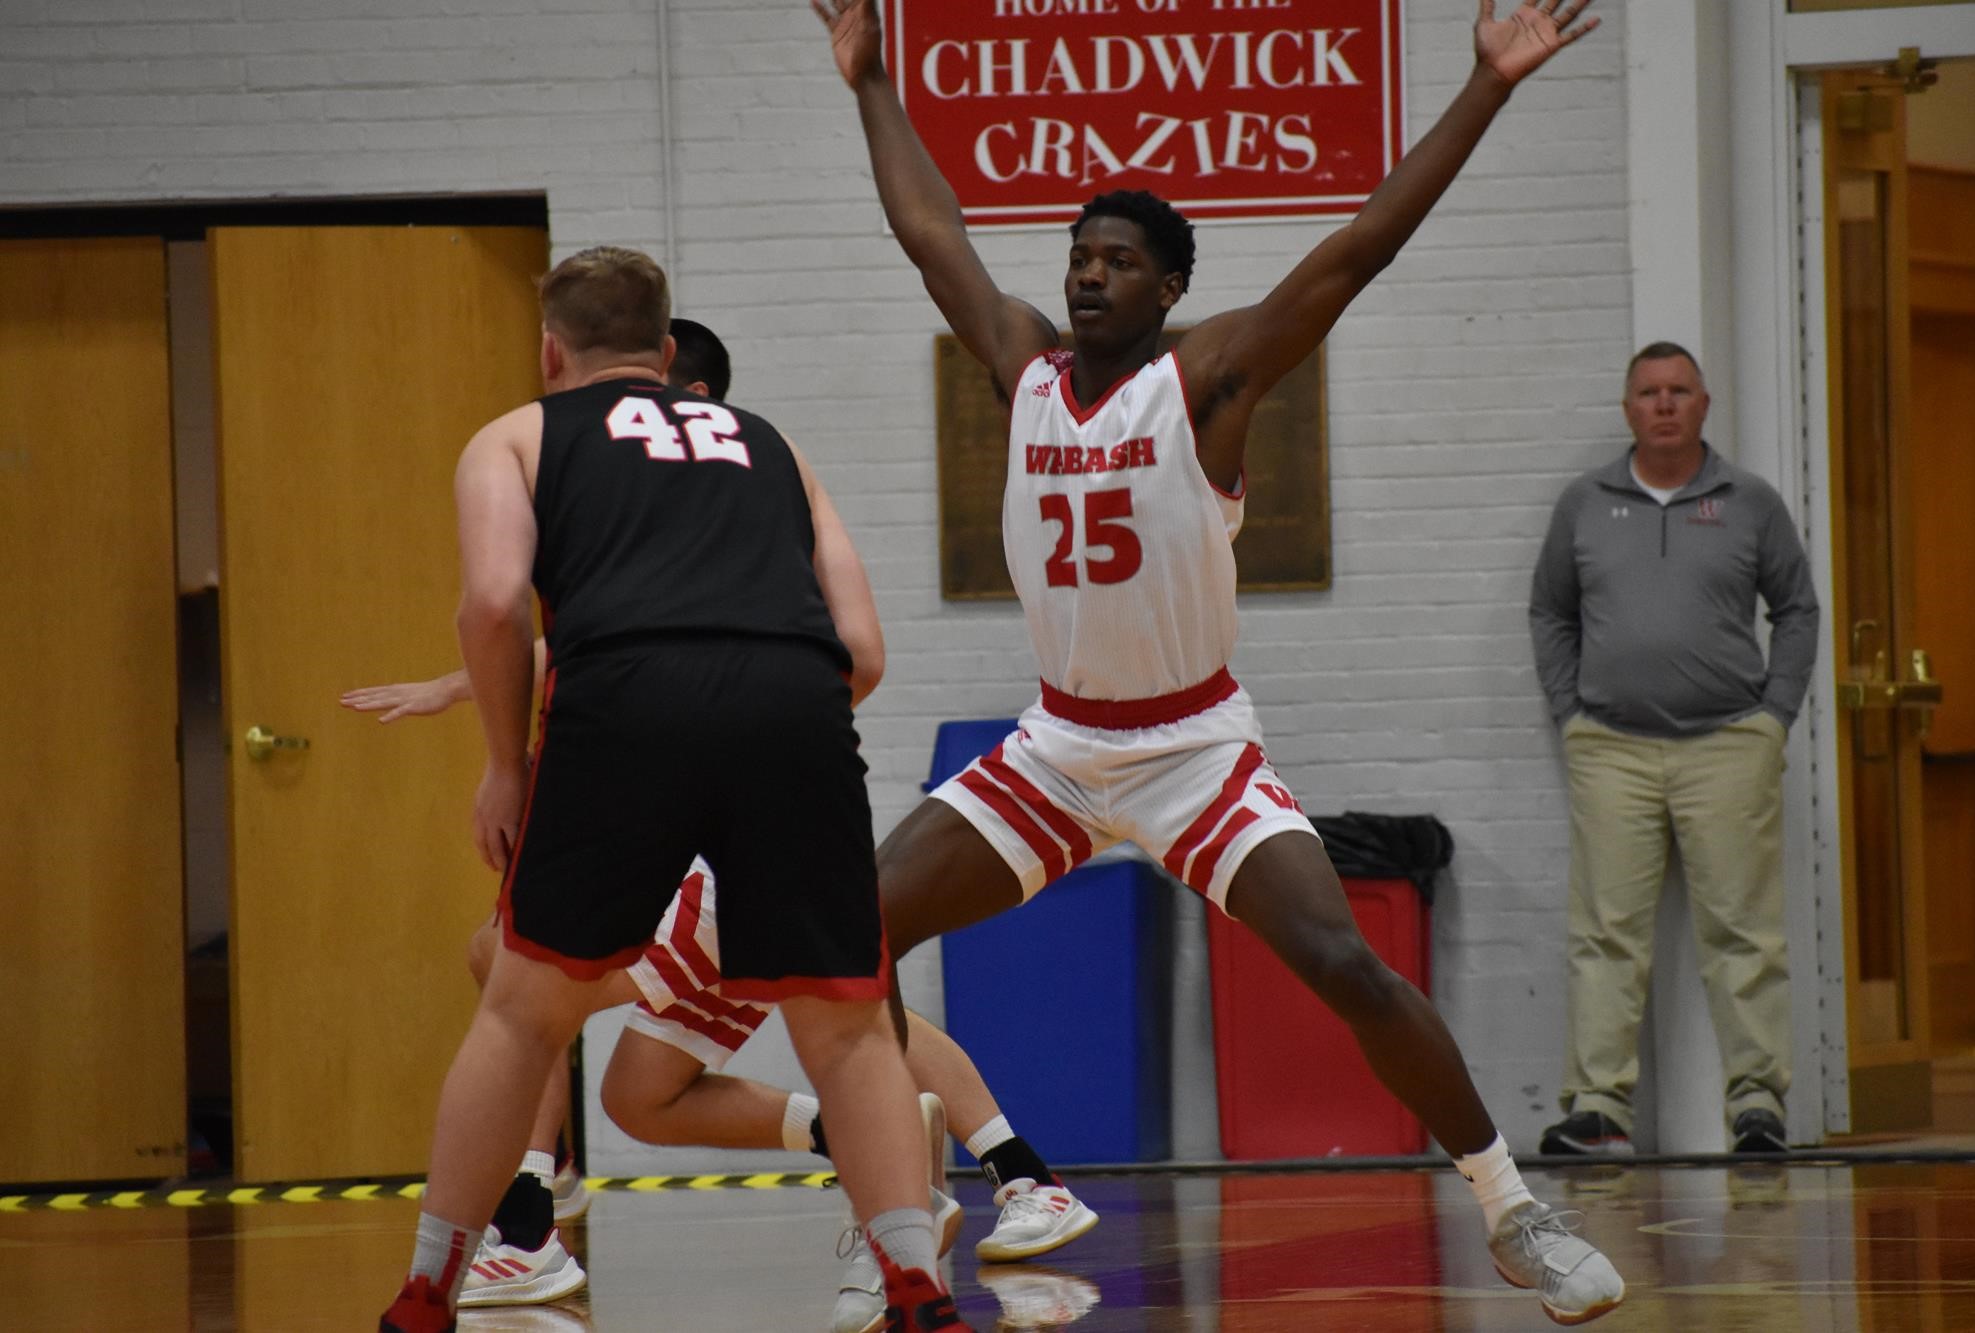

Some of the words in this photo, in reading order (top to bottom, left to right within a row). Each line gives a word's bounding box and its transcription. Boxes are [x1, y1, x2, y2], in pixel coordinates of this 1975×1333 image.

[921, 28, 1363, 99] CHADWICK
[974, 110, 1318, 187] CRAZIES
[605, 396, 752, 469] 42
[1025, 436, 1157, 475] WABASH
[1039, 487, 1143, 588] 25
